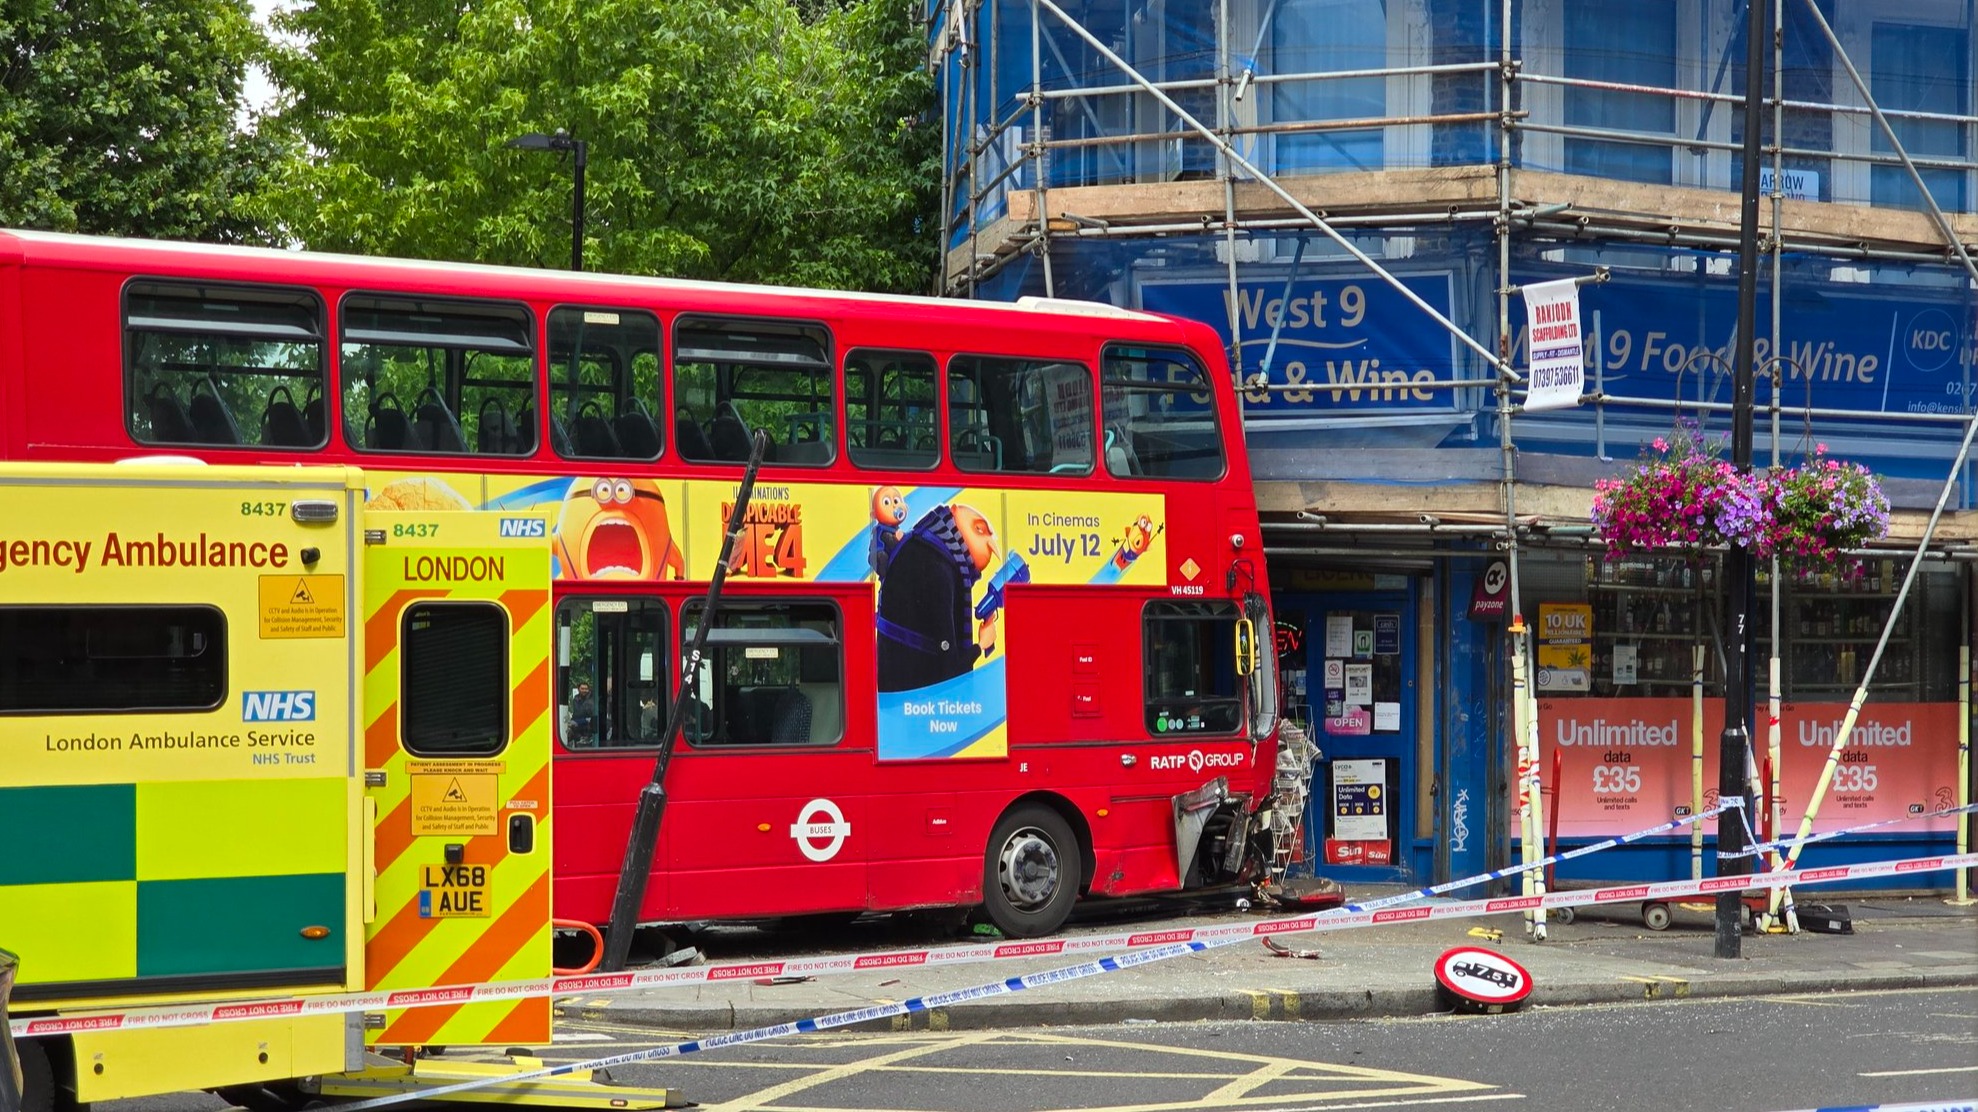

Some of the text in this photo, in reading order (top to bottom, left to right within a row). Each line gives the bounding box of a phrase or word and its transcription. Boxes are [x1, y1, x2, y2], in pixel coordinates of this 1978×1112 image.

[1223, 285, 1366, 330] West 9
[1532, 323, 1578, 343] SCAFFOLDING LTD
[1911, 328, 1951, 351] KDC
[1606, 329, 1632, 370] 9
[1752, 337, 1774, 379] &
[1789, 341, 1879, 384] Wine
[1283, 361, 1314, 403] &
[1326, 359, 1436, 402] Wine
[241, 502, 287, 517] 8437
[500, 518, 545, 537] NHS
[1027, 512, 1100, 528] In Cinemas
[393, 523, 439, 538] 8437
[101, 532, 289, 569] Ambulance
[776, 522, 807, 578] 4
[1028, 533, 1101, 564] July 12
[404, 555, 504, 582] LONDON
[1171, 585, 1204, 595] VH 45119
[1474, 600, 1504, 612] payzone
[1546, 614, 1586, 629] 10 UK
[243, 691, 314, 721] NHS
[904, 700, 982, 716] Book Tickets
[929, 719, 958, 733] Now
[1334, 718, 1363, 728] OPEN
[46, 729, 316, 752] London Ambulance Service
[1557, 719, 1678, 747] Unlimited
[252, 752, 316, 765] NHS Trust
[1150, 752, 1244, 770] RATP GROUP
[1604, 750, 1631, 764] data
[1842, 750, 1868, 763] data
[1020, 762, 1028, 773] JE
[1593, 765, 1641, 794] £35
[1832, 765, 1878, 792] £35
[810, 826, 832, 834] BUSES
[1337, 846, 1363, 858] Sun
[1368, 850, 1388, 860] Sun
[426, 866, 486, 888] LX68
[439, 891, 483, 912] AUE
[665, 973, 679, 981] NOT
[680, 971, 704, 980] CROSS
[477, 988, 493, 996] FIRE
[507, 986, 522, 994] NOT
[524, 984, 549, 993] CROSS
[128, 1016, 146, 1024] FIRE
[162, 1014, 178, 1022] NOT
[180, 1012, 208, 1021] CROSS
